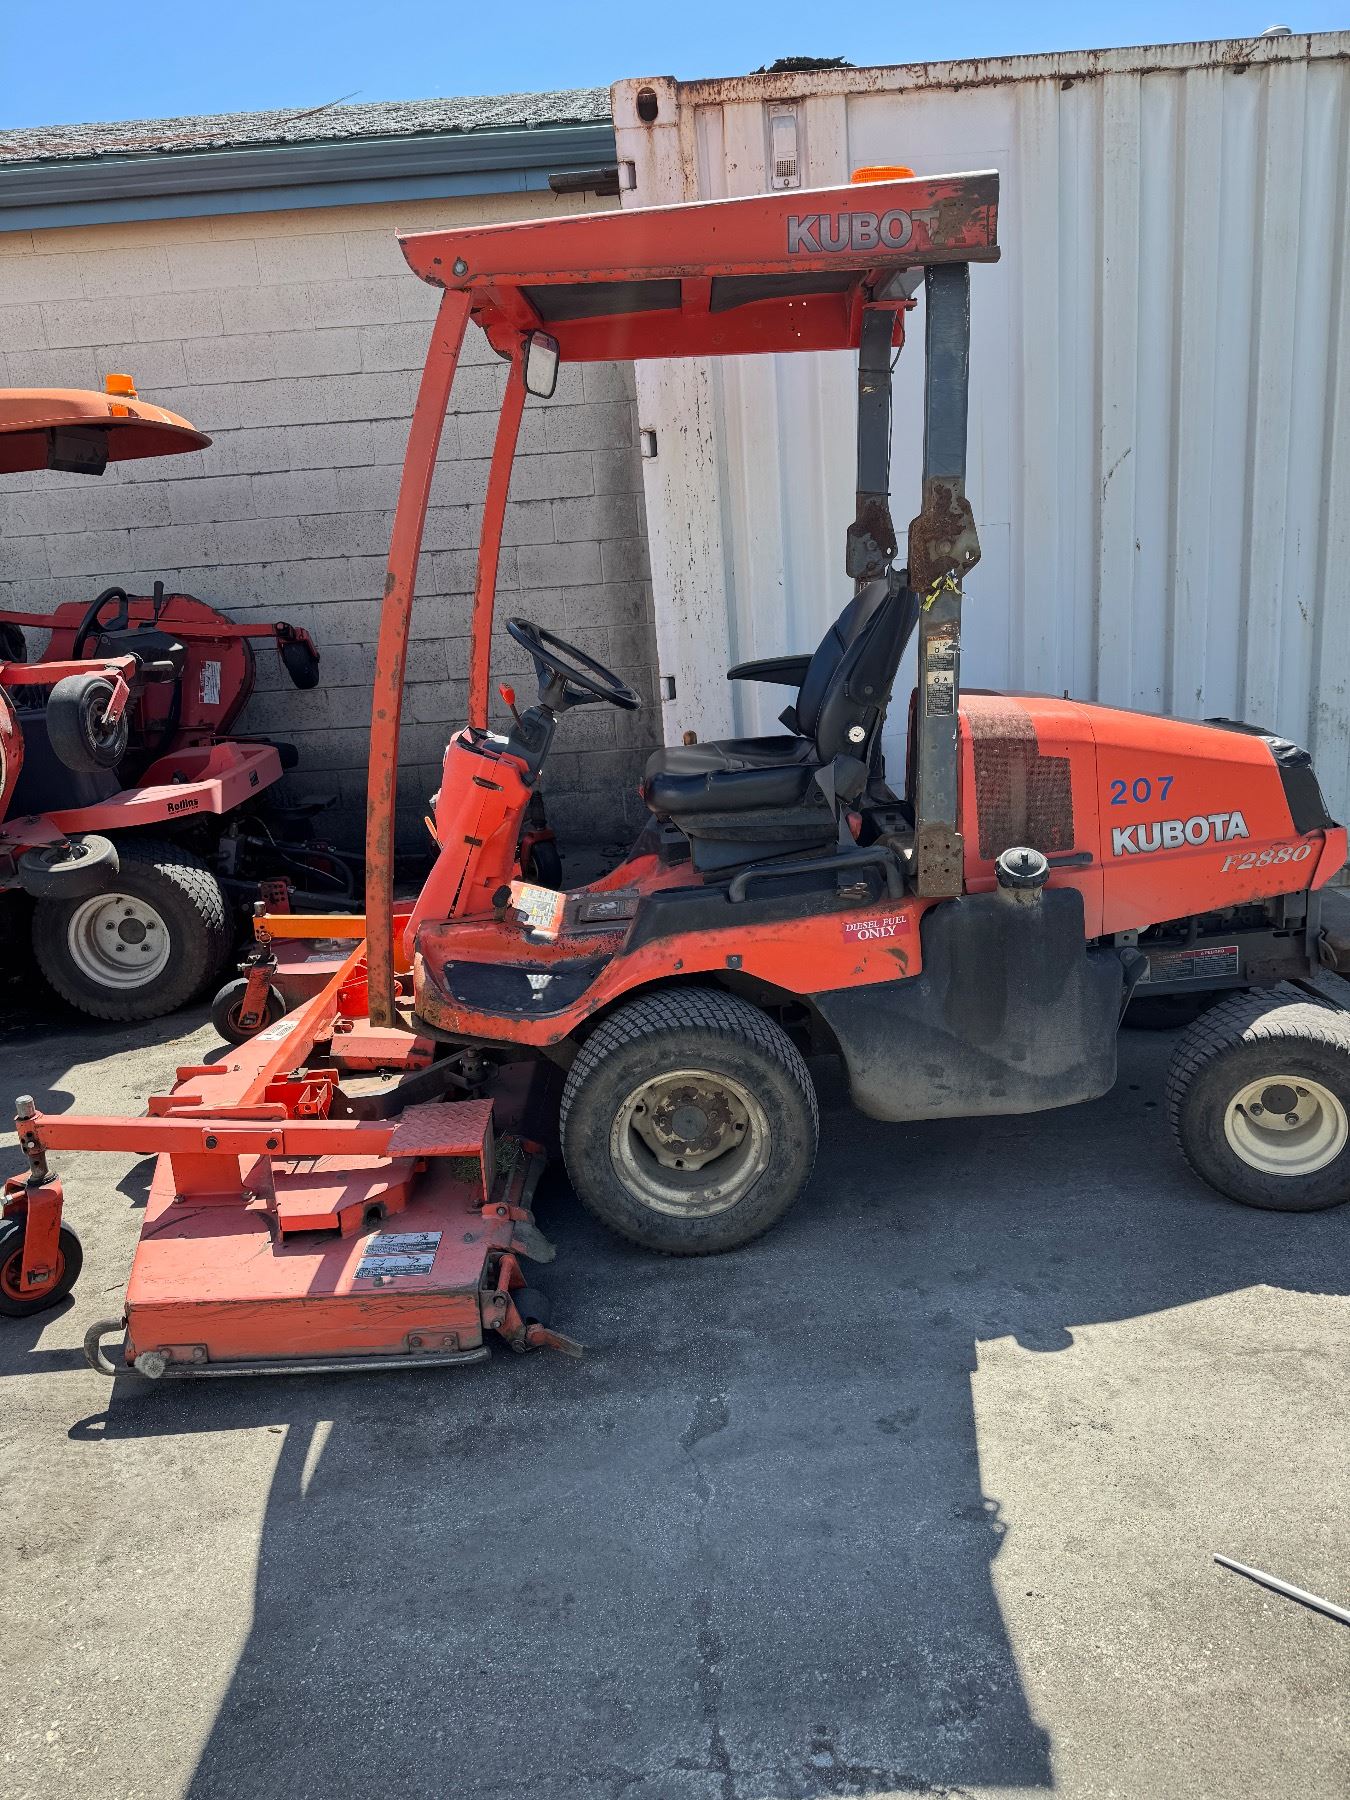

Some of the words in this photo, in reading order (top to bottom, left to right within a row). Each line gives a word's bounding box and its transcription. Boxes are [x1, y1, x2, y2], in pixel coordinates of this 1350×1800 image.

[787, 208, 943, 253] KUBOT
[1110, 776, 1174, 805] 207
[167, 798, 199, 813] Rollins
[1112, 811, 1250, 856] KUBOTA
[1220, 845, 1312, 873] F2880
[845, 921, 880, 932] DIESEL
[883, 915, 907, 927] FUEL
[857, 925, 897, 940] ONLY
